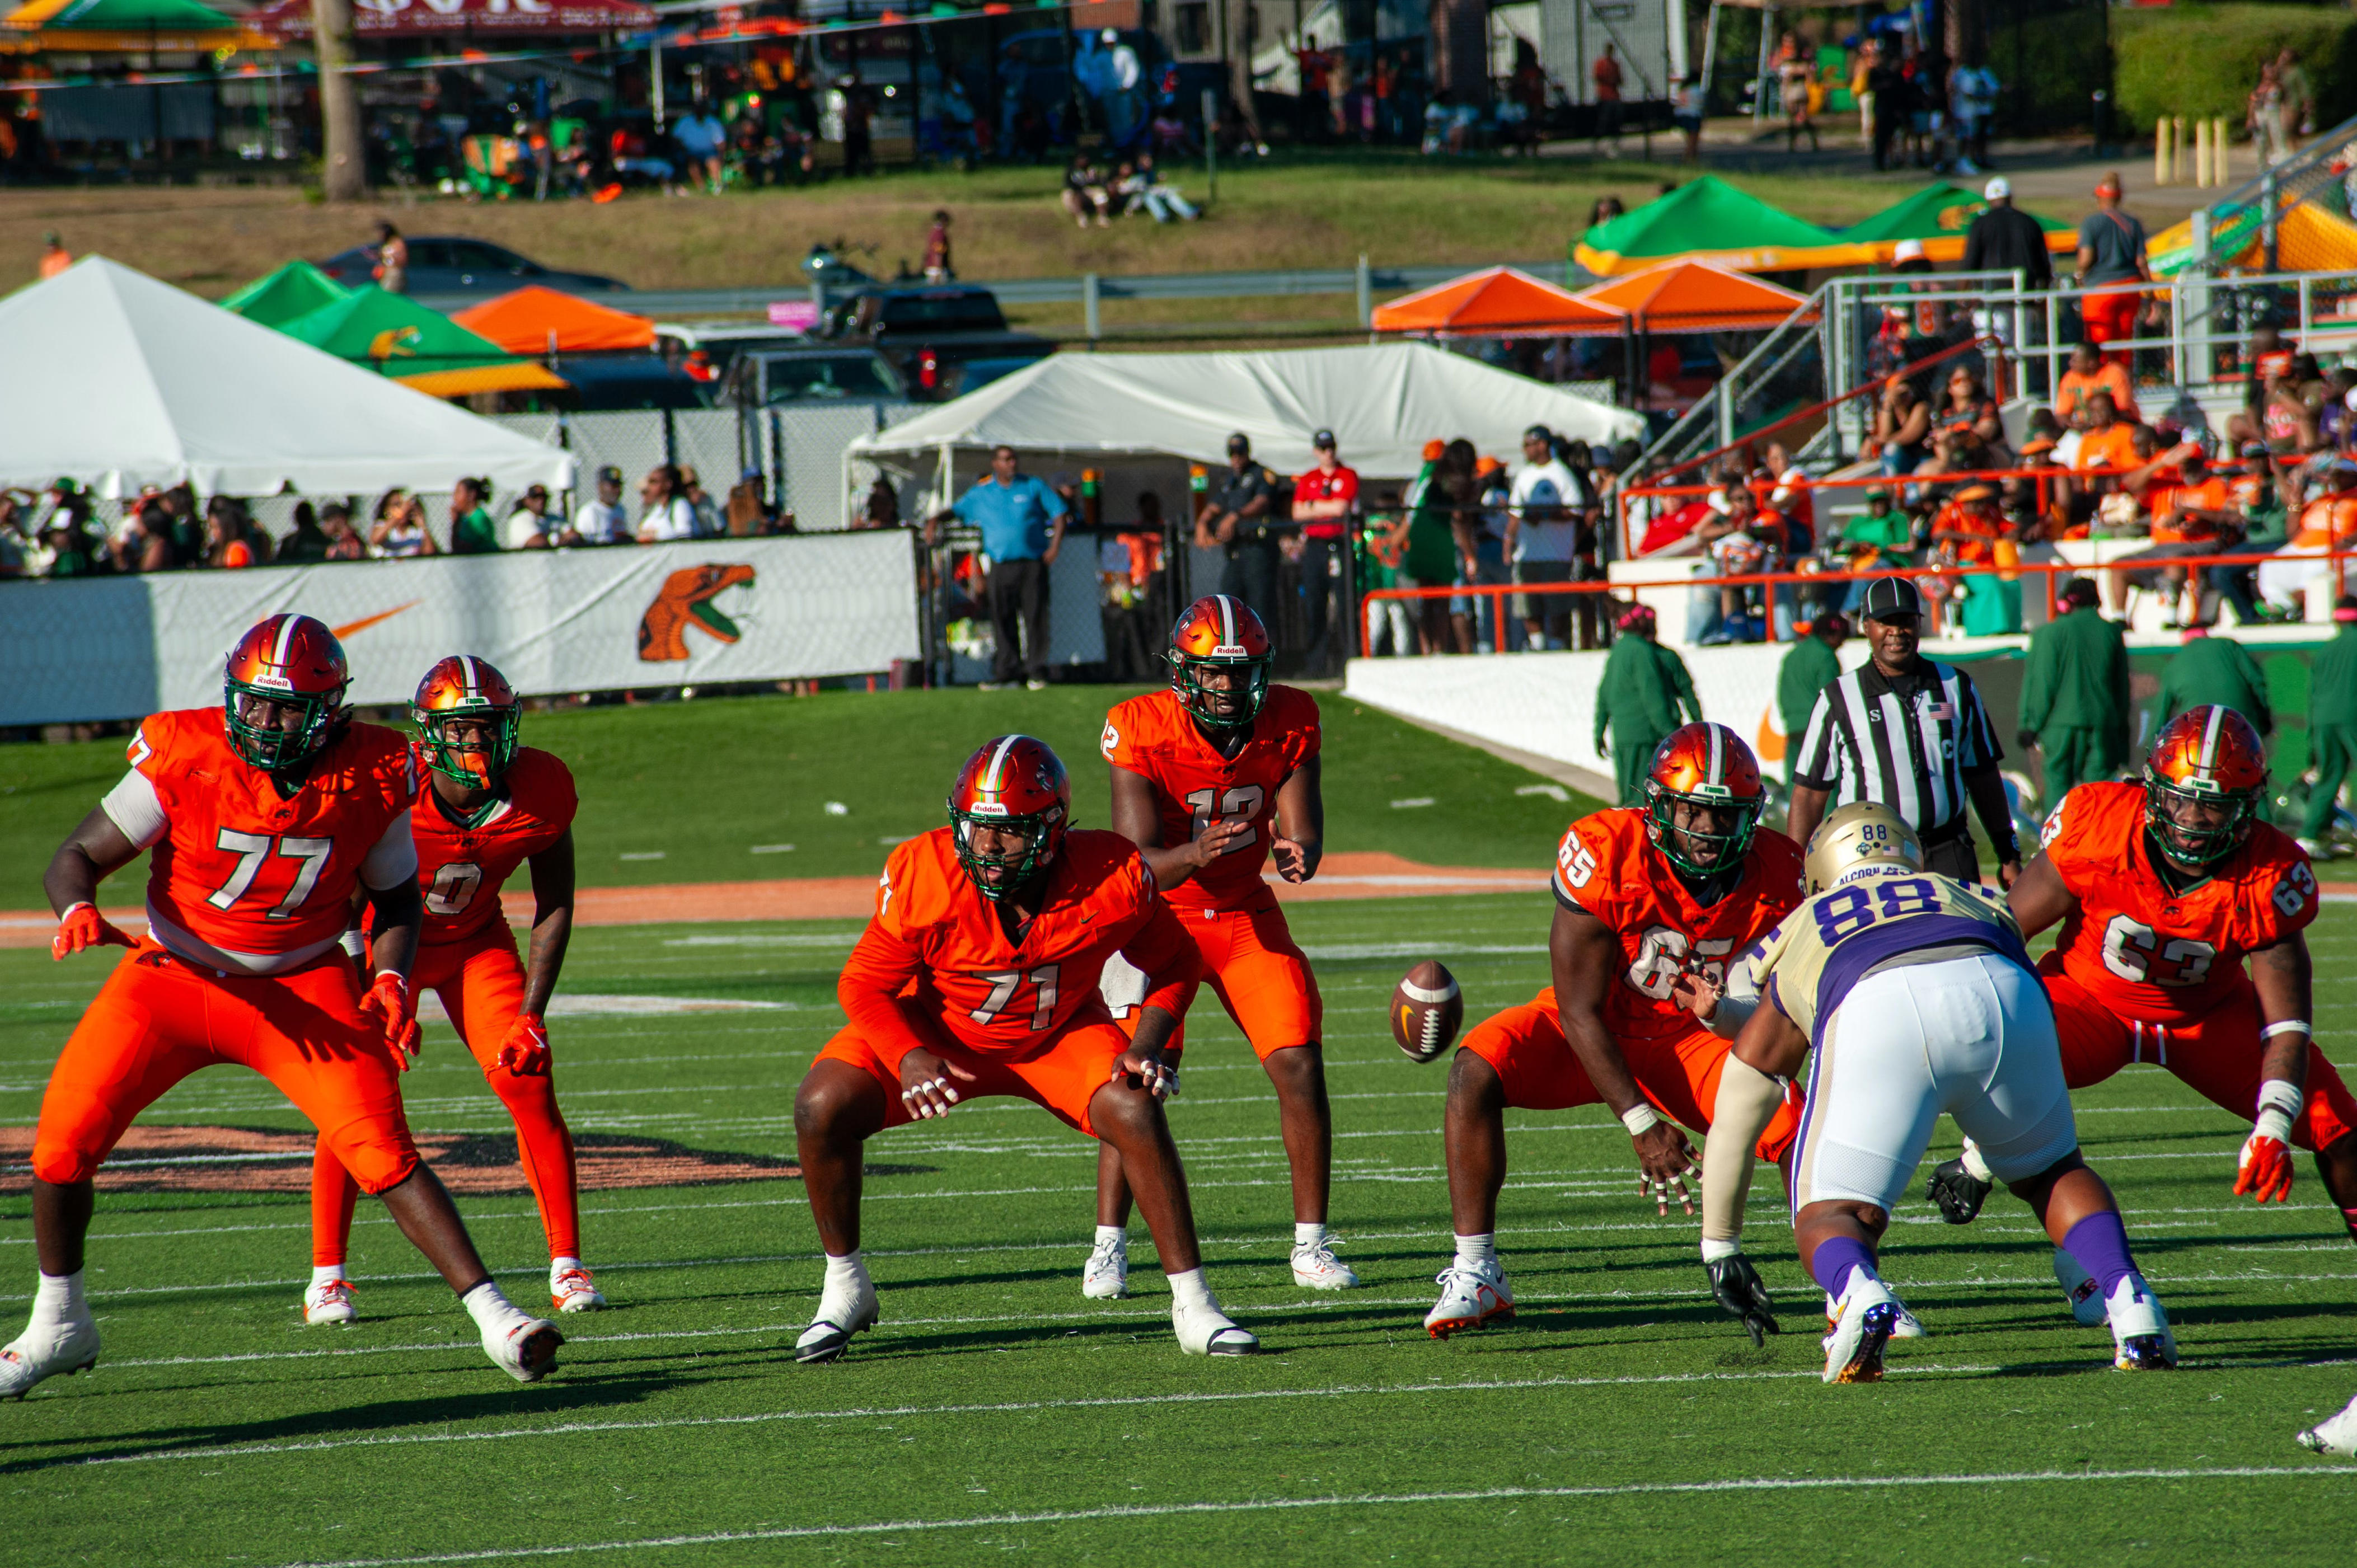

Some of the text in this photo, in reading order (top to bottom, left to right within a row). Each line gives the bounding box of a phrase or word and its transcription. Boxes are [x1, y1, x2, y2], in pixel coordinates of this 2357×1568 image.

[257, 675, 288, 687] Riddell
[1869, 710, 1881, 722] S
[1941, 739, 1953, 759] C
[974, 804, 1004, 814] Riddell
[1185, 783, 1265, 855] 12
[1862, 824, 1888, 841] 88
[206, 827, 334, 919] 77
[1558, 830, 1597, 889] 65
[1839, 867, 1880, 885] ALCORN
[424, 861, 482, 915] 0
[1813, 878, 1942, 947] 88
[2272, 860, 2317, 917] 63
[2101, 913, 2217, 987] 63
[968, 964, 1061, 1031] 71
